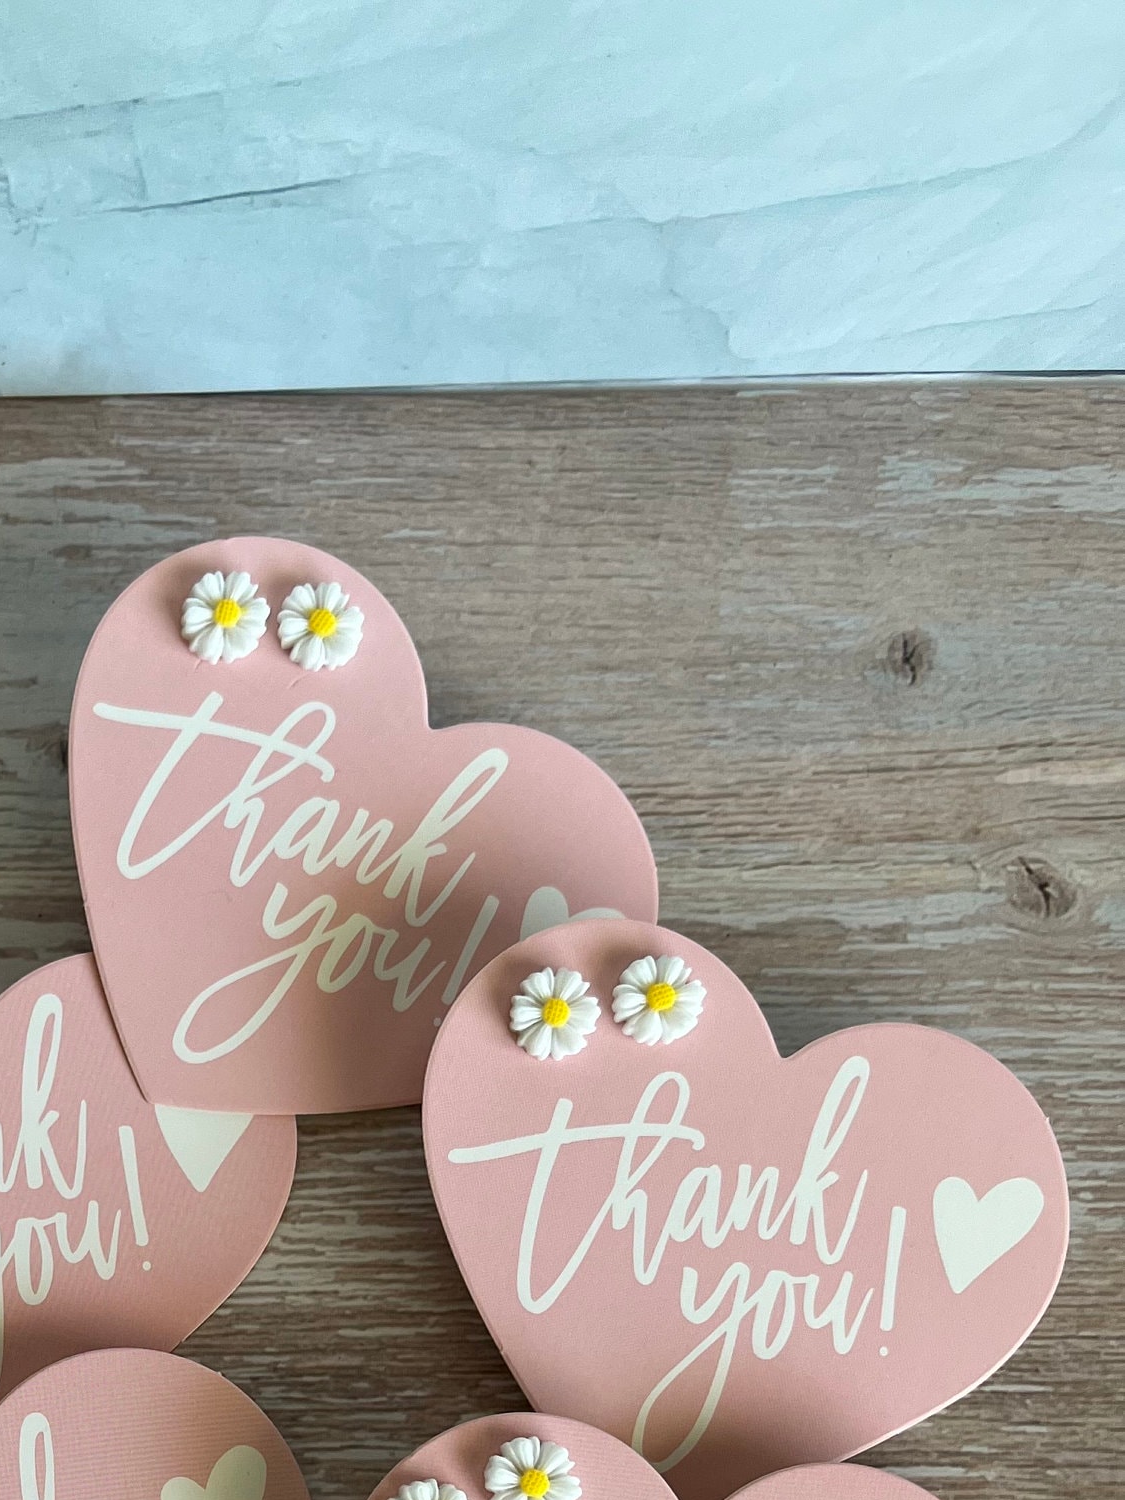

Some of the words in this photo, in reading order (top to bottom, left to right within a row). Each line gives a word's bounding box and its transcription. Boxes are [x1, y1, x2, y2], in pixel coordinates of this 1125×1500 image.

[93, 691, 509, 926] thank
[173, 882, 500, 1064] you!
[448, 1055, 870, 1315] thank
[632, 1206, 906, 1471] you!
